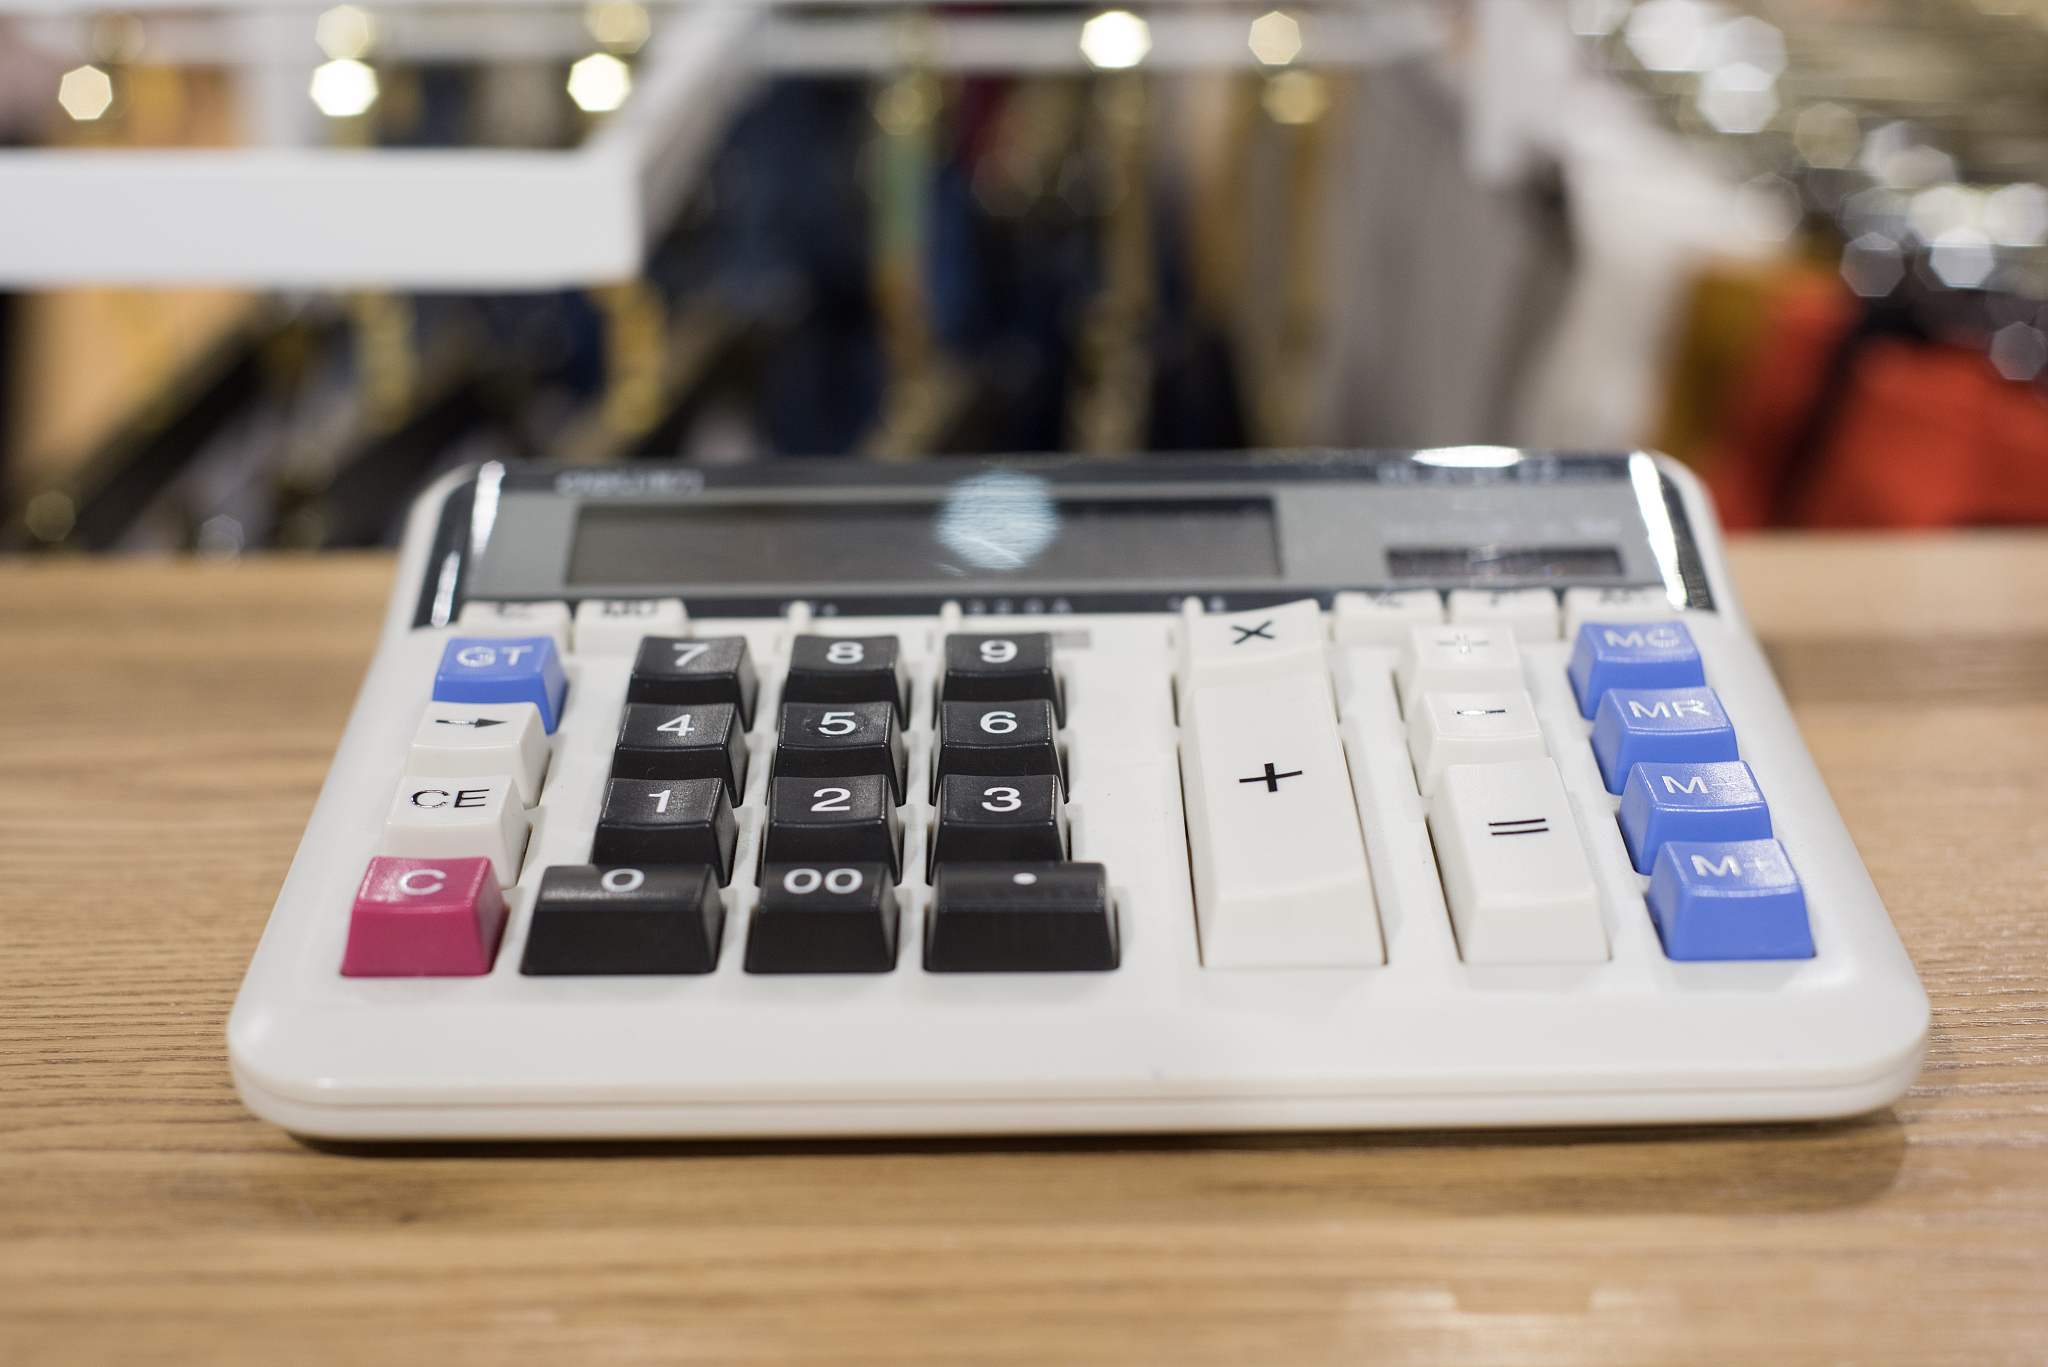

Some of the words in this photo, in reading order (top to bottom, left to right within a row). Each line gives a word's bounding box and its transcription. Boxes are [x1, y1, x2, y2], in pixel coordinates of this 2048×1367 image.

[456, 645, 534, 668] GT
[672, 642, 709, 667] 7
[827, 643, 863, 663] 8
[981, 641, 1016, 662] 9
[1628, 699, 1711, 719] MR
[657, 714, 694, 736] 4
[819, 712, 856, 734] 5
[981, 712, 1017, 733] 6
[410, 788, 491, 809] CE
[649, 790, 670, 812] 1
[811, 788, 850, 811] 2
[982, 787, 1021, 811] 3
[398, 868, 447, 896] C
